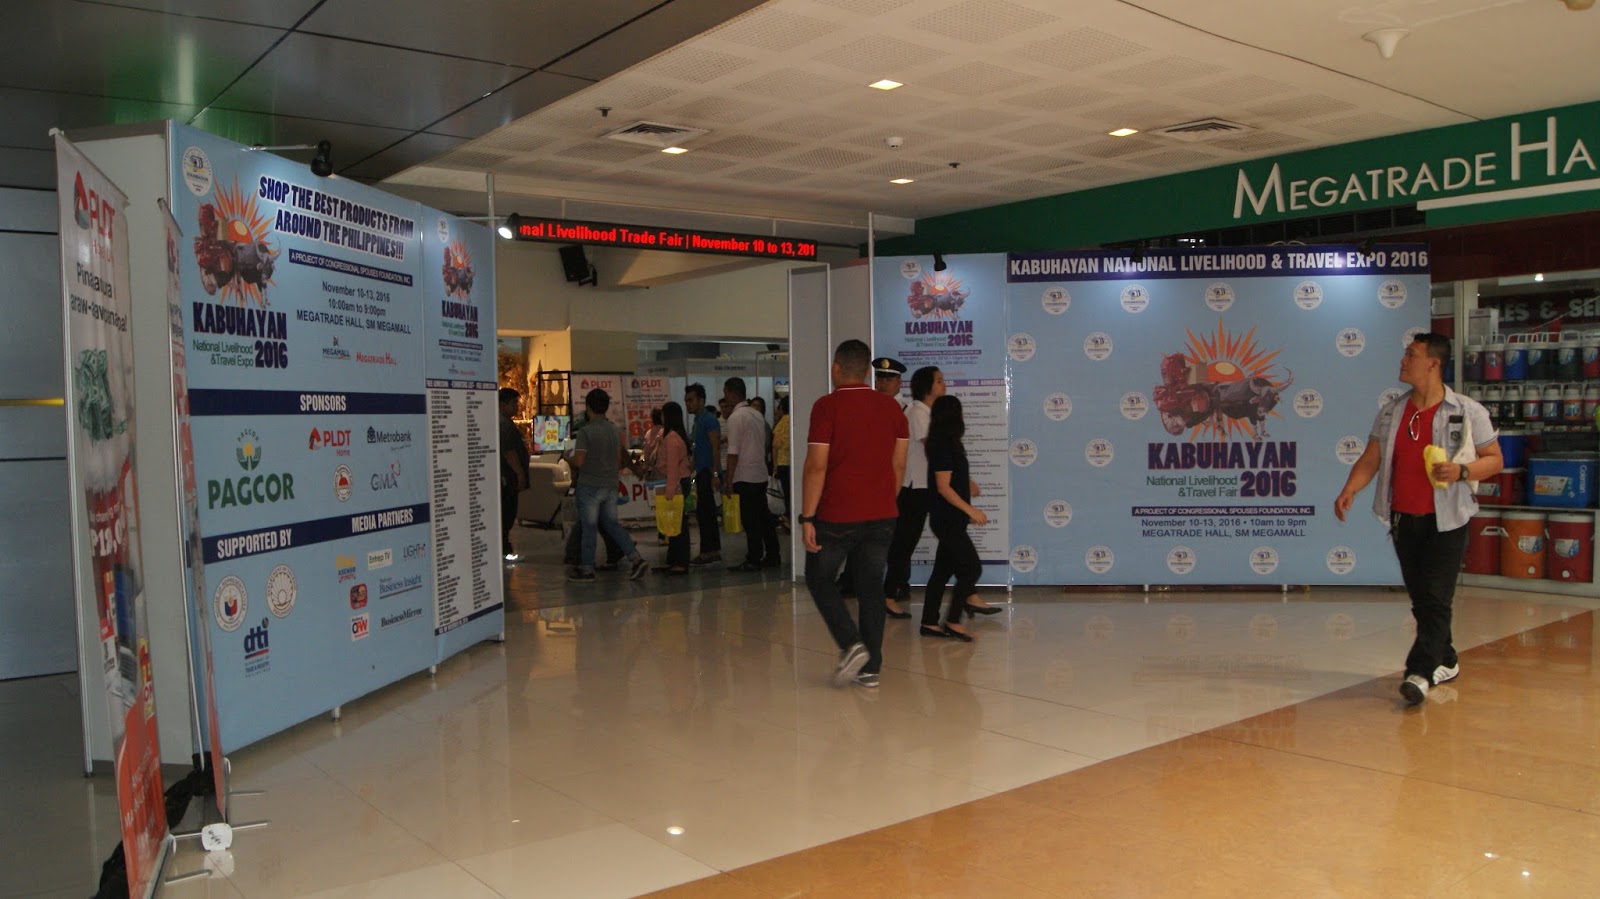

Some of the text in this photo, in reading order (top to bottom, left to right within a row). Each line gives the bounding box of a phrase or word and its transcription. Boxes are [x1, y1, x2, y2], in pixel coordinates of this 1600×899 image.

[1233, 152, 1497, 219] MEGATRADE
[89, 189, 116, 239] PLDT
[259, 176, 414, 239] SHOP THE BEST PRODUCTS FROM
[275, 209, 404, 261] AROUND THE PHILIPPINES!!!
[548, 224, 617, 242] Livelihood
[619, 229, 656, 245] Trade
[659, 231, 684, 246] Fair
[692, 235, 750, 252] November
[752, 240, 764, 253] 10
[767, 242, 778, 254] to
[780, 241, 795, 257] 13,
[797, 243, 815, 256] 201
[296, 253, 318, 266] PROJECT
[318, 257, 325, 267] OF
[1010, 250, 1429, 276] KABUHAYAN NATIONAL LIVELIHOOD & TRAVEL EXPO 2016
[322, 281, 391, 303] November 10-13, 2016
[328, 298, 387, 317] 10:00am to 9:00pm
[192, 301, 288, 340] KABUHAYAN
[296, 309, 412, 335] MEGATRADE HALL, SM MEGAMALL
[905, 320, 973, 335] KABUHAYAN
[192, 339, 253, 354] National Livelihood
[947, 334, 973, 347] 2016
[237, 355, 254, 368] Expo
[254, 340, 289, 369] 2016
[322, 348, 350, 358] MEGAMALL
[591, 380, 613, 389] PLDT
[641, 380, 662, 388] PLDT
[300, 394, 347, 412] SPONSORS
[323, 430, 351, 447] PLDT
[375, 429, 412, 443] Metrobank
[1147, 441, 1297, 470] KABUHAYAN
[370, 472, 398, 491] GMA
[1146, 475, 1237, 486] National Livelihood
[1240, 470, 1297, 497] 2016
[207, 472, 295, 510] PAGCOR
[1178, 486, 1238, 497] &Travel Fair
[351, 507, 414, 534] MEDIA PARTNERS
[1141, 518, 1307, 529] November 10-13, 2016 10am to 9pm
[1142, 528, 1306, 539] MEGATRADE HALL, SM MEGAMALL
[216, 528, 293, 559] SUPPORTED BY
[369, 551, 391, 564] Entrep TV
[381, 607, 423, 628] BusinessMirror
